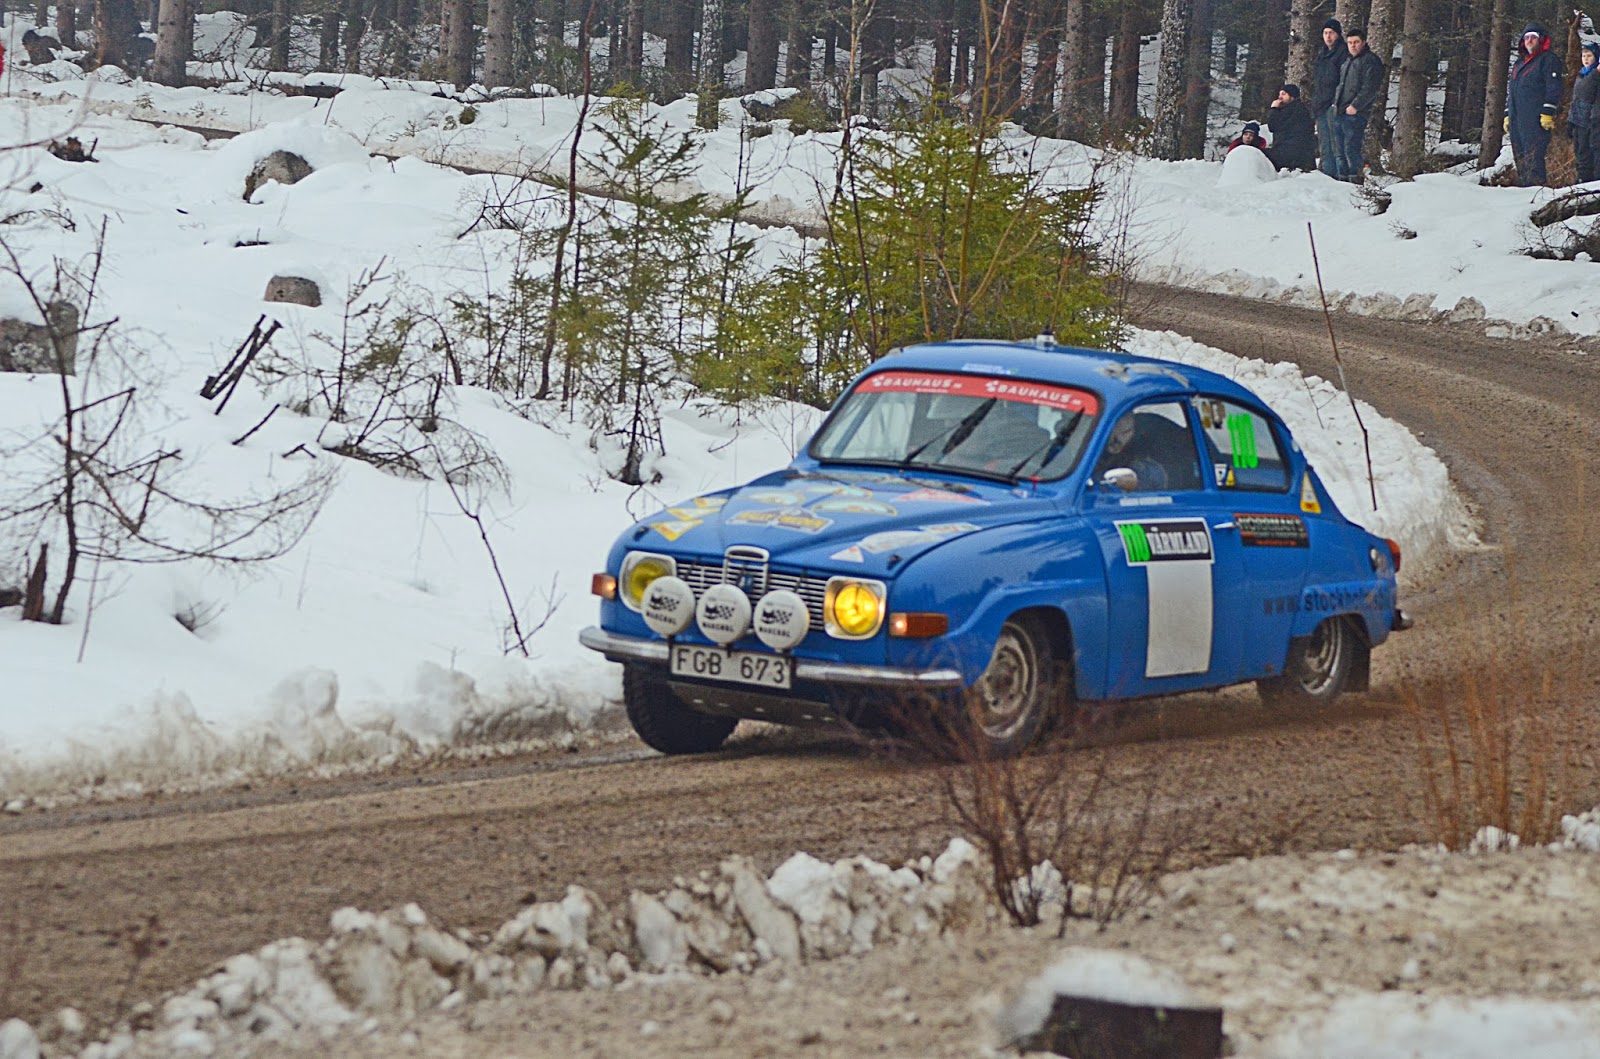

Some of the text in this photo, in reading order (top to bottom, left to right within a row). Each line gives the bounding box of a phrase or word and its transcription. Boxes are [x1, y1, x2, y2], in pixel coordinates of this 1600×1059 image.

[882, 378, 952, 388] BAUHAUS
[997, 384, 1072, 402] BAUHAUS
[676, 649, 785, 684] FGB 673
